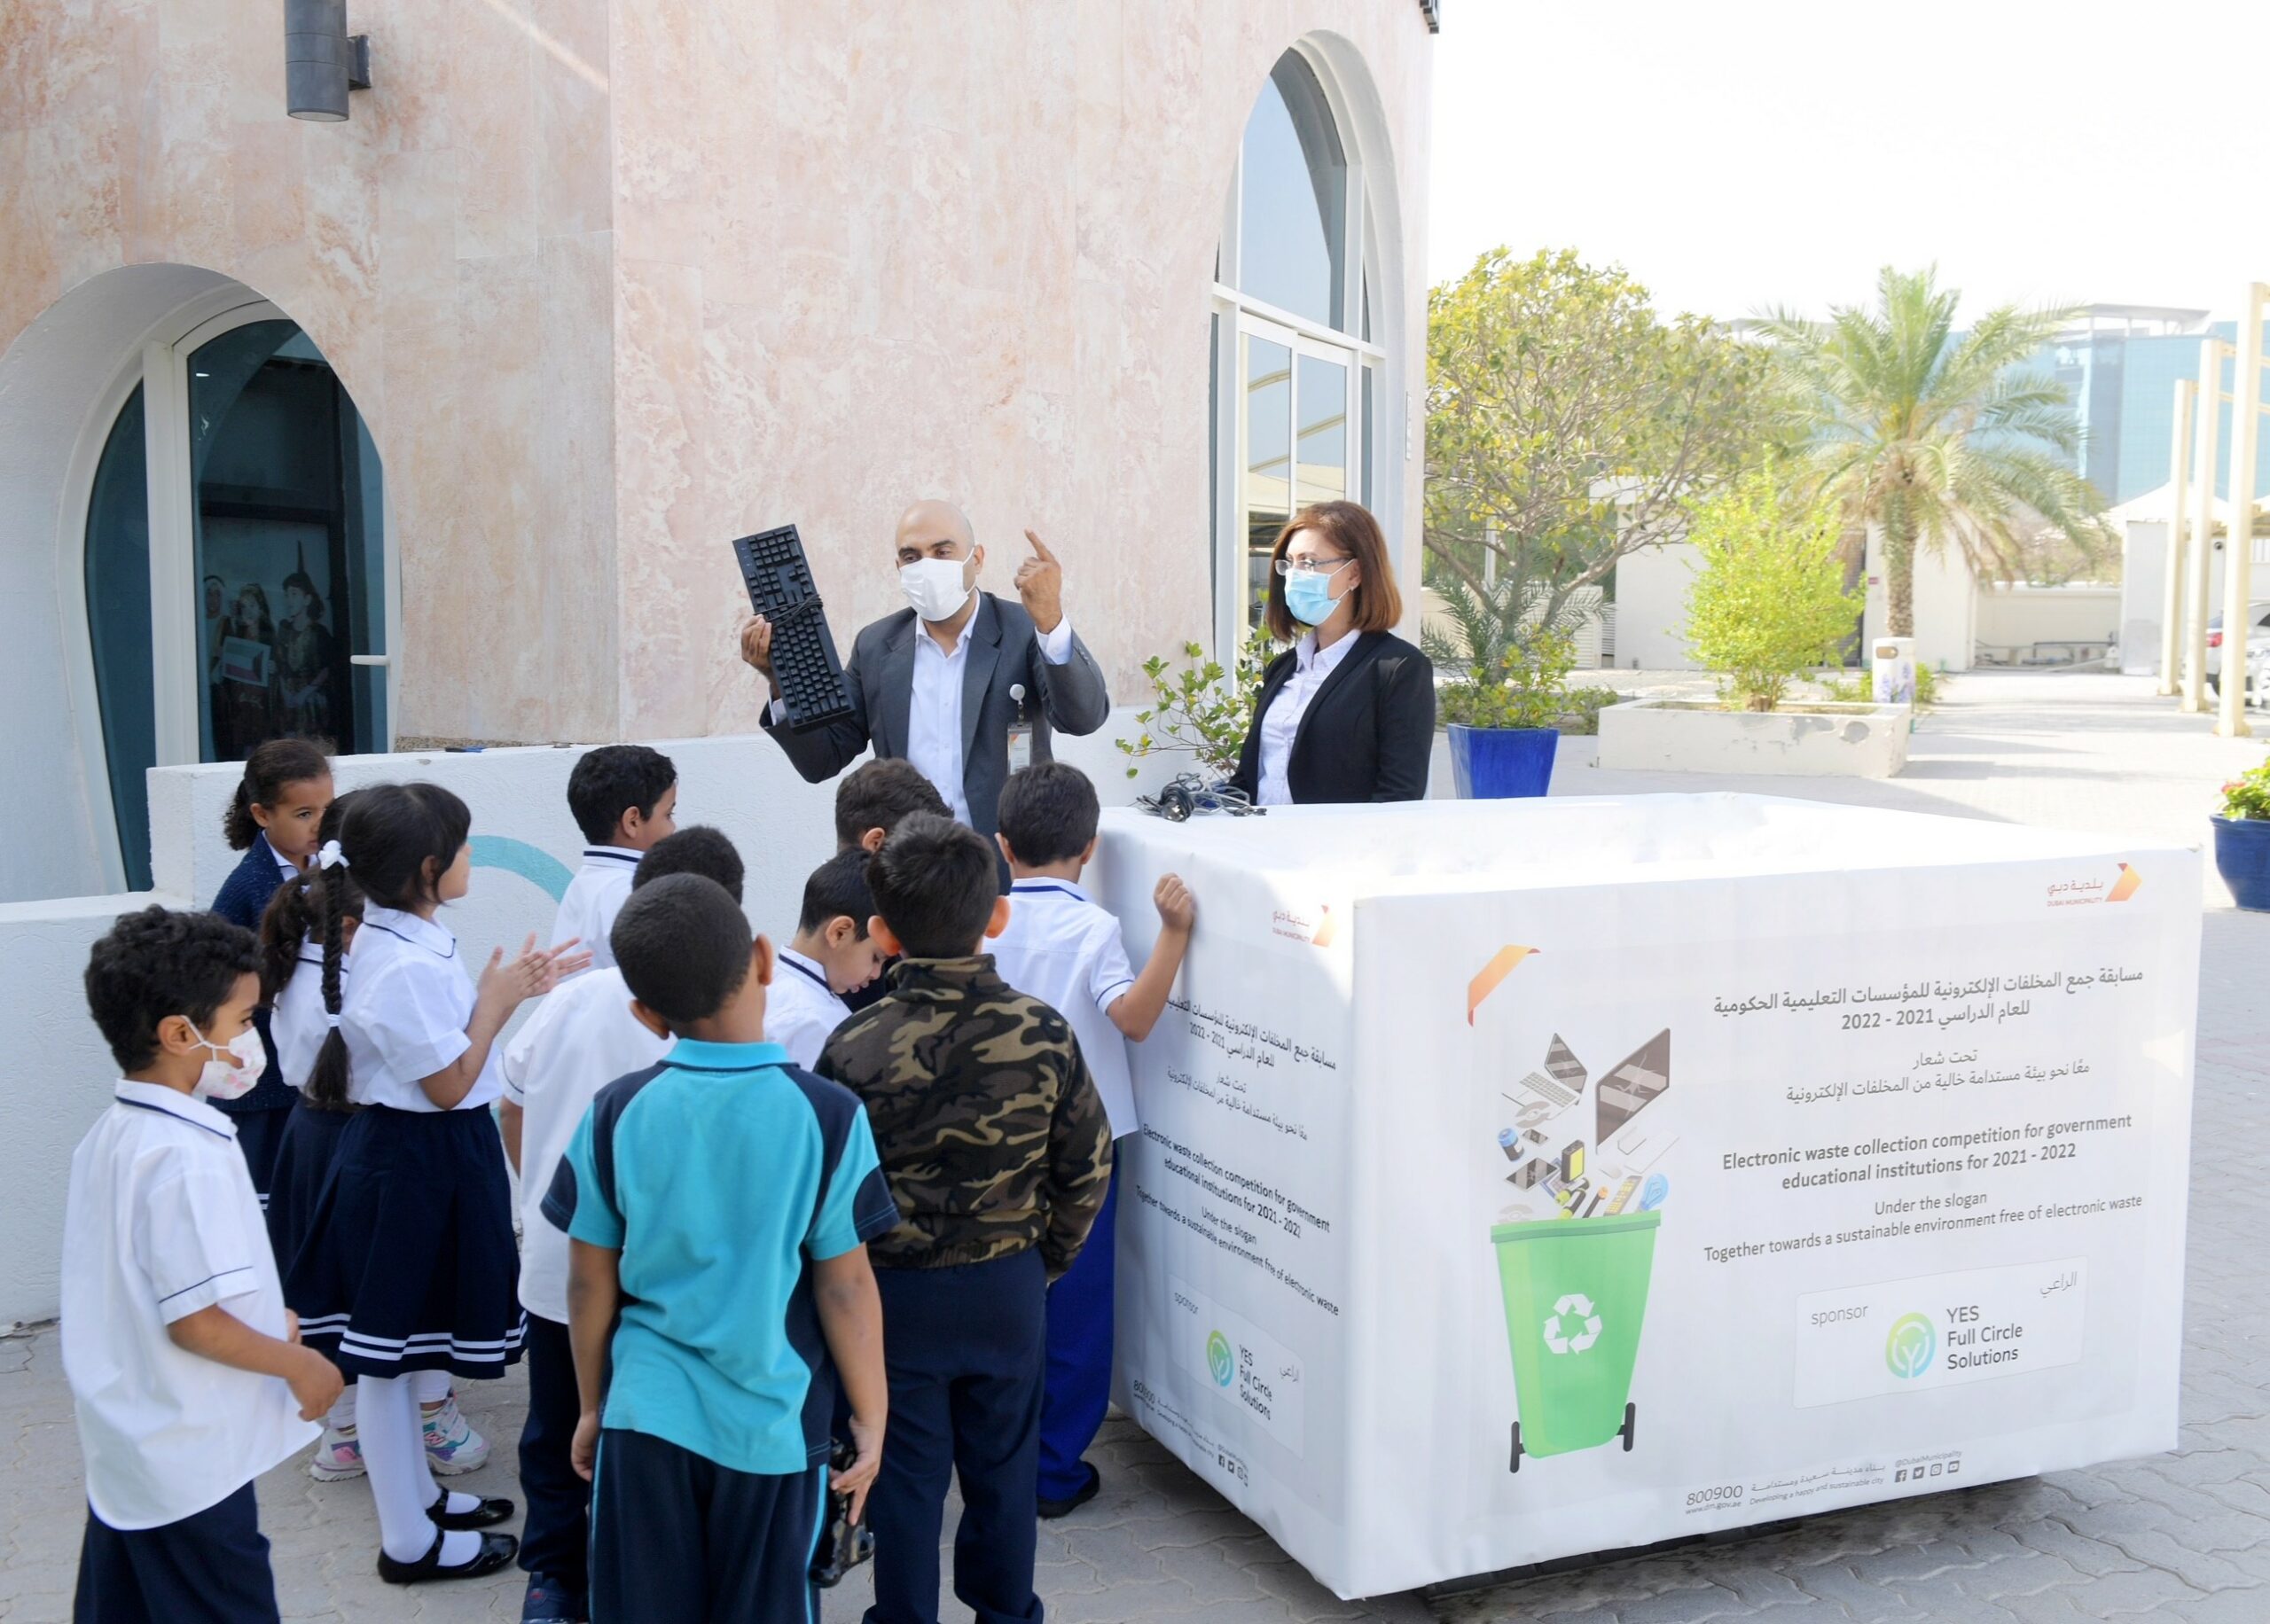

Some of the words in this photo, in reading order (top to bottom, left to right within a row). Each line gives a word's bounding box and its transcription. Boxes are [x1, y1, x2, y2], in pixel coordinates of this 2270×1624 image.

[2003, 972, 2062, 991] المخلفات
[2066, 973, 2094, 994] جمع
[2099, 966, 2143, 987] مسابقة
[1782, 988, 1846, 1011] التعليمية
[1851, 982, 1930, 1003] للمؤسسات
[1934, 977, 2000, 1001] الإلكترونية
[1714, 993, 1778, 1017] الحكومية
[1938, 1003, 1994, 1030] الدراسي
[1998, 1000, 2030, 1024] للعام
[1842, 1012, 1881, 1030] 2022
[1896, 1008, 1934, 1026] 2021
[1256, 1050, 1274, 1068] للعام
[1913, 1050, 1945, 1070] شعار
[1949, 1050, 1978, 1064] تحت
[1935, 1072, 1965, 1091] خالية
[1969, 1069, 2020, 1085] مستدامة
[2024, 1066, 2046, 1081] بيئة
[2050, 1063, 2069, 1080] نحو
[1786, 1081, 1848, 1105] الإلكترونية
[1852, 1076, 1909, 1097] المخلفات
[1913, 1078, 1931, 1093] من
[1723, 1147, 1801, 1170] Electronic
[1805, 1144, 1850, 1161] waste
[1854, 1136, 1928, 1156] collection
[1932, 1127, 2020, 1150] competition
[2024, 1123, 2045, 1138] for
[2047, 1114, 2132, 1139] government
[1782, 1165, 1871, 1189] educational
[1875, 1158, 1963, 1179] institutions
[1967, 1155, 1988, 1170] for
[1992, 1150, 2027, 1167] 2021
[2040, 1143, 2076, 1160] 2022
[1143, 1123, 1171, 1149] Electronic
[1173, 1143, 1192, 1159] waste
[1193, 1152, 1223, 1176] collection
[1225, 1170, 1273, 1198] competition
[1274, 1189, 1286, 1206] for
[1287, 1199, 1330, 1233] government
[1164, 1157, 1200, 1185] educational
[1202, 1175, 1242, 1206] institutions
[1243, 1197, 1256, 1213] for
[1257, 1204, 1277, 1224] 2021
[1875, 1198, 1915, 1215] Under
[1920, 1196, 1941, 1211] the
[1945, 1192, 1987, 1210] slogan
[1202, 1206, 1219, 1226] Under
[1220, 1217, 1233, 1233] the
[1234, 1224, 1257, 1245] slogan
[1704, 1242, 1765, 1263] Together
[1769, 1232, 1821, 1253] towards
[1825, 1234, 1833, 1245] a
[1836, 1222, 1910, 1243] sustainable
[1914, 1212, 1995, 1233] environment
[2000, 1209, 2024, 1223] free
[2028, 1206, 2042, 1220] of
[2046, 1198, 2106, 1218] electronic
[2109, 1195, 2142, 1210] waste
[1218, 1238, 1264, 1268] environment
[1264, 1258, 1275, 1277] free
[1276, 1269, 1285, 1281] of
[1284, 1273, 1315, 1303] electronic
[1316, 1295, 1339, 1316] waste
[2039, 1271, 2078, 1298] الراعي
[1811, 1305, 1868, 1327] sponsor
[1946, 1306, 1979, 1323] YES
[1948, 1328, 1976, 1347] Full
[1981, 1323, 2023, 1343] Circle
[1239, 1344, 1253, 1366] YES
[1947, 1347, 2018, 1370] Solutions
[1240, 1364, 1251, 1385] Full
[1252, 1375, 1272, 1401] Circle
[1240, 1384, 1271, 1420] Solutions
[1687, 1485, 1743, 1506] 800900
[1749, 1493, 1788, 1505] Developing
[1795, 1487, 1814, 1498] happy
[1815, 1482, 1828, 1491] and
[1829, 1478, 1870, 1490] sustainable
[1871, 1476, 1884, 1486] city
